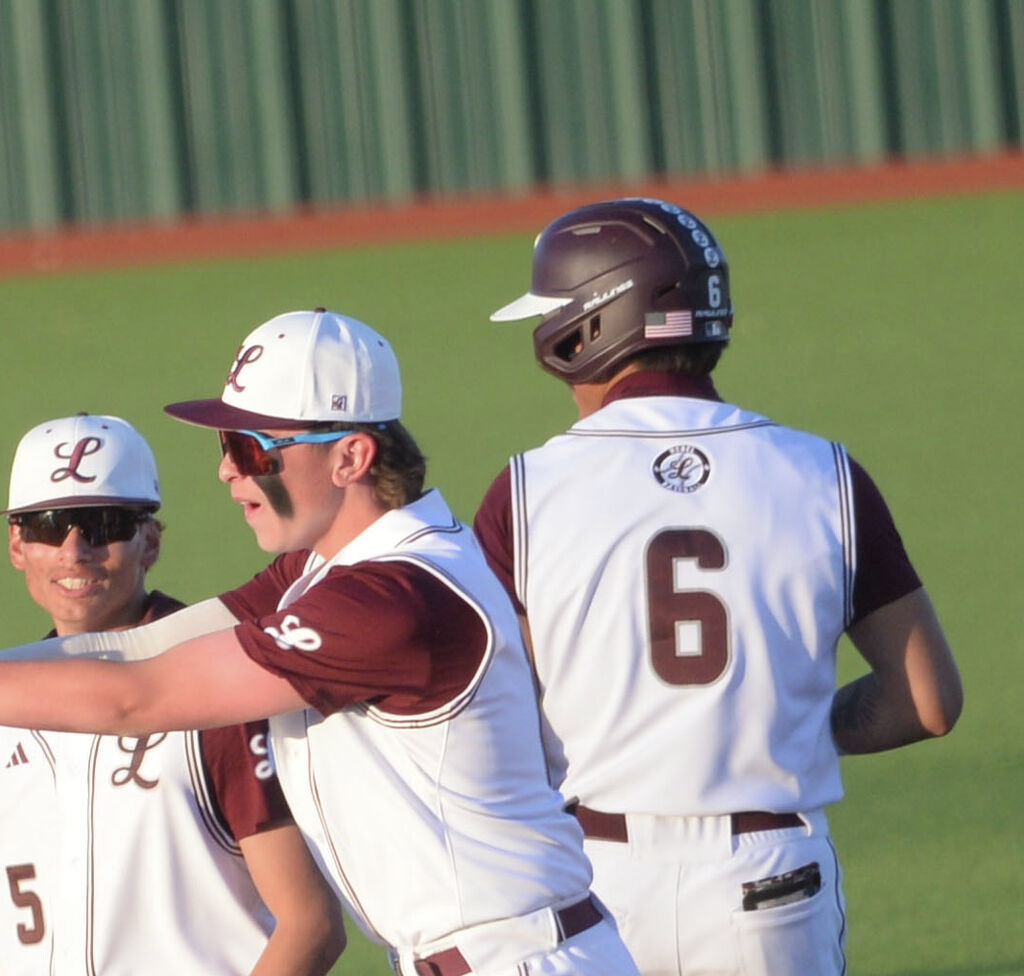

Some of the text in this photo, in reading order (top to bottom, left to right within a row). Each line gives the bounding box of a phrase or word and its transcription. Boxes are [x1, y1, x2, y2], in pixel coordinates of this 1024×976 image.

[707, 275, 721, 309] 6
[225, 345, 264, 393] L
[50, 436, 103, 484] L
[643, 524, 733, 689] 6
[111, 733, 168, 790] L
[6, 863, 45, 945] 5
